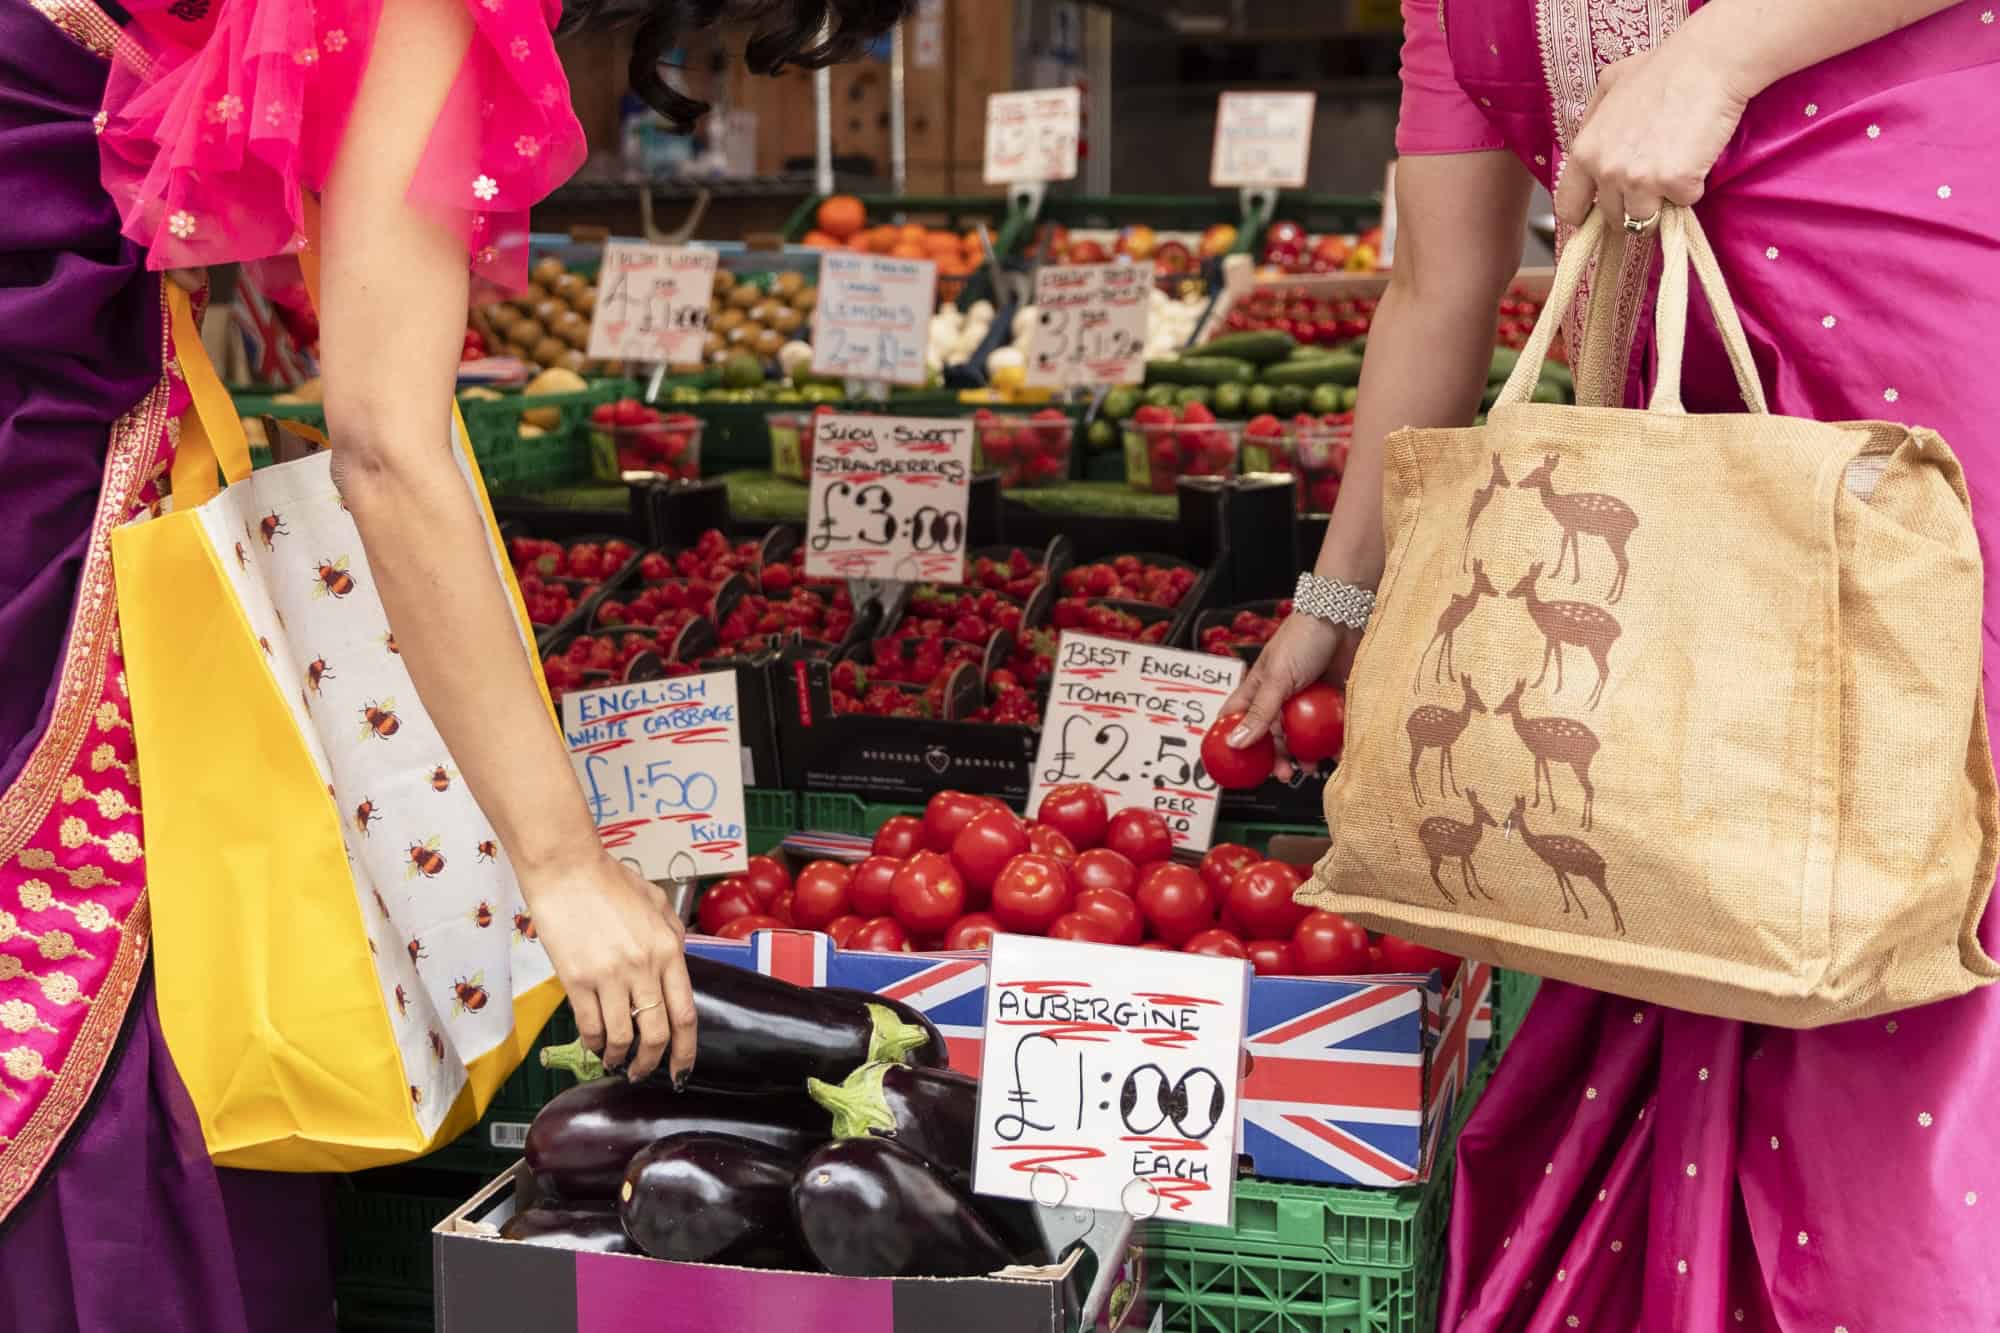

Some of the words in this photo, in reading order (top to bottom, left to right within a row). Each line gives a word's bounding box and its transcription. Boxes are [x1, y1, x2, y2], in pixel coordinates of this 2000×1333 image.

[823, 298, 915, 324] LEMONS
[1062, 642, 1131, 668] BEST
[643, 704, 735, 734] CABBAGE
[585, 755, 717, 825] £1:50
[1154, 796, 1199, 815] PER
[995, 1032, 1225, 1141] £1:00
[1133, 1151, 1208, 1181] EACH
